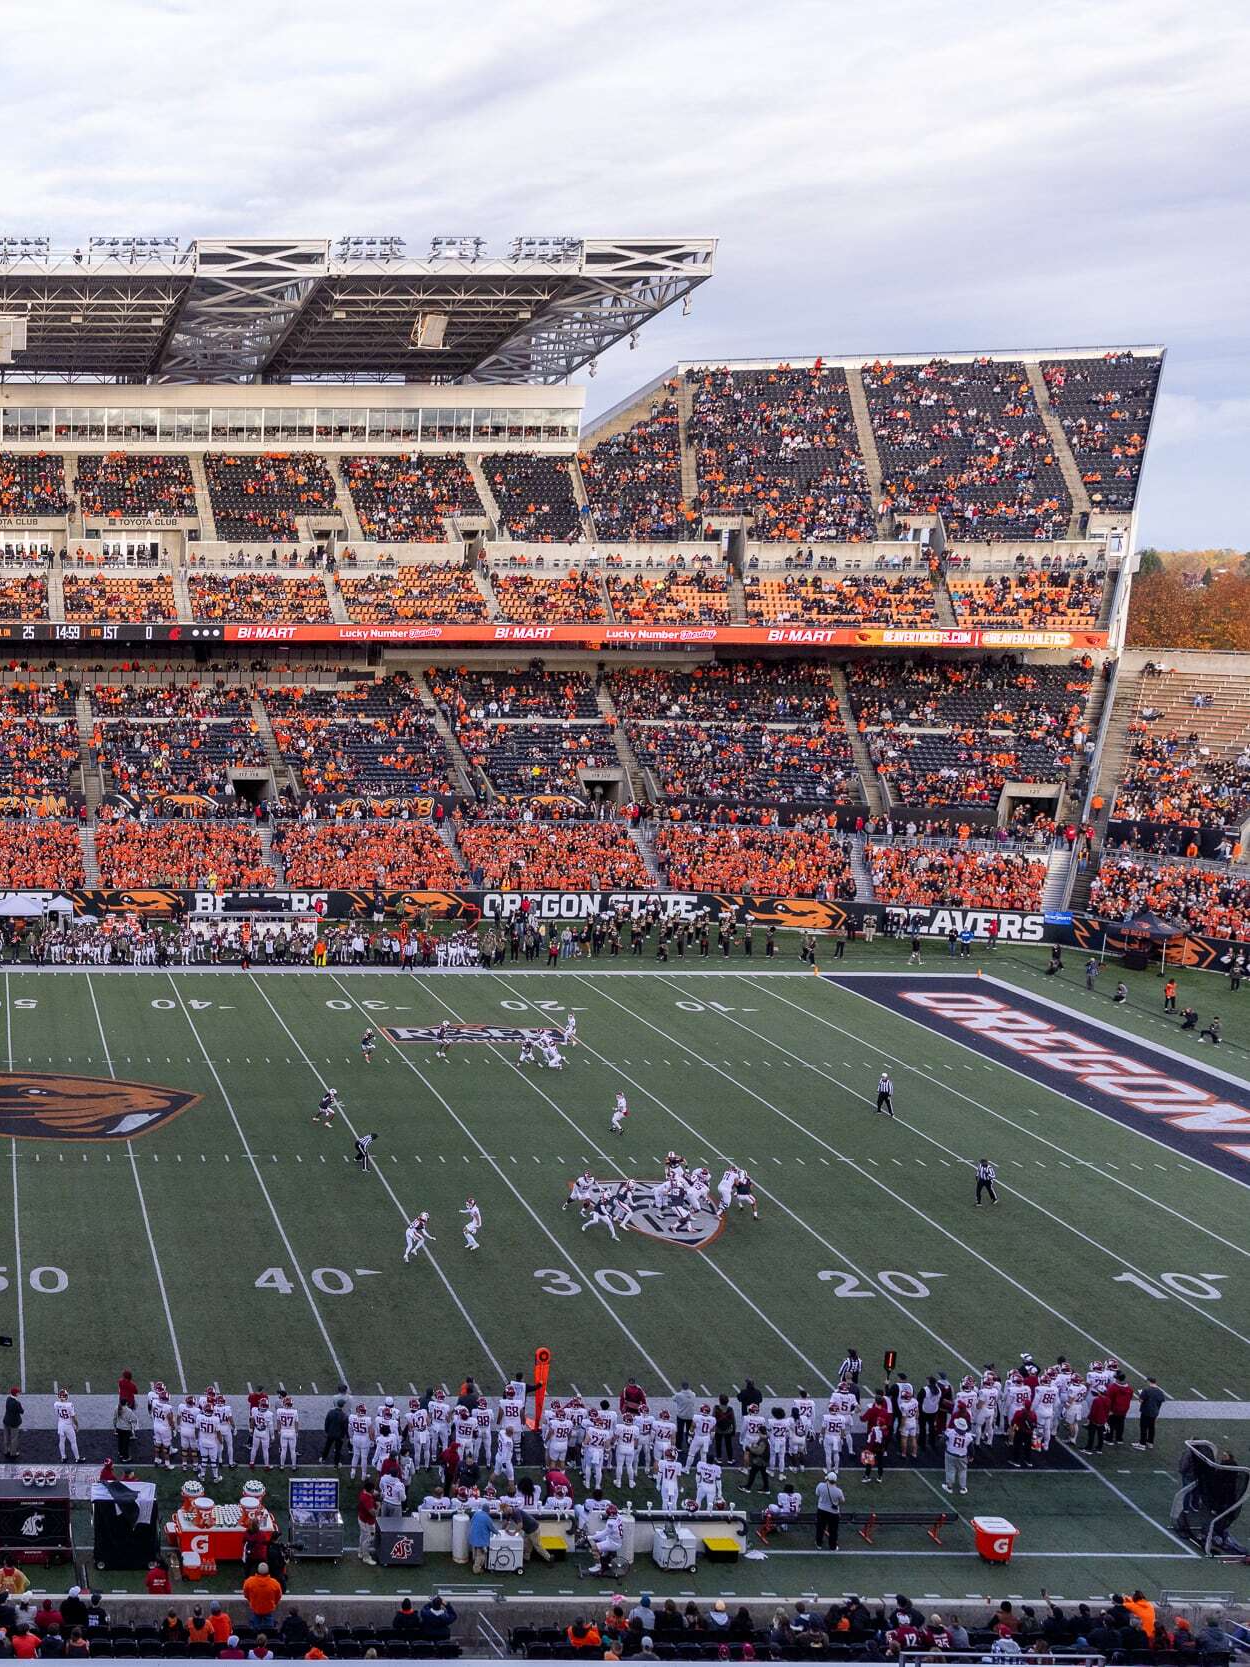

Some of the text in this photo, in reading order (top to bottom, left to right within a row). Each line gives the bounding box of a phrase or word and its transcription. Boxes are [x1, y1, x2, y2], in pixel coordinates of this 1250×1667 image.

[16, 518, 39, 526] CLUB
[118, 518, 177, 526] TOYOTA CLUB
[23, 625, 35, 639] 25
[55, 625, 80, 639] 14:59
[103, 625, 119, 639] 1ST
[146, 625, 153, 639] 0
[340, 628, 368, 639] Lucky
[370, 629, 408, 638] Number
[606, 629, 636, 640] Lucky
[638, 629, 678, 639] Number
[883, 631, 971, 643] BEAVERTICKETS.COM
[195, 892, 329, 914] BERS
[898, 991, 1250, 1133] OREGON
[253, 1266, 354, 1294] 40
[533, 1268, 641, 1296] 30
[817, 1269, 930, 1298] 20
[1112, 1272, 1222, 1300] 10
[181, 1411, 194, 1424] 55
[434, 1408, 443, 1421] 12
[505, 1405, 519, 1417] 68
[200, 1421, 213, 1433] 50
[281, 1415, 293, 1427] 97
[352, 1421, 367, 1434] 95
[477, 1415, 490, 1427] 98
[828, 1421, 842, 1433] 85
[657, 1429, 671, 1440] 44
[701, 1422, 709, 1434] 0
[622, 1432, 633, 1443] 51
[665, 1467, 675, 1480] 17
[386, 1485, 393, 1497] 3
[790, 1501, 797, 1513] 5
[190, 1534, 209, 1554] G
[993, 1537, 1010, 1554] G
